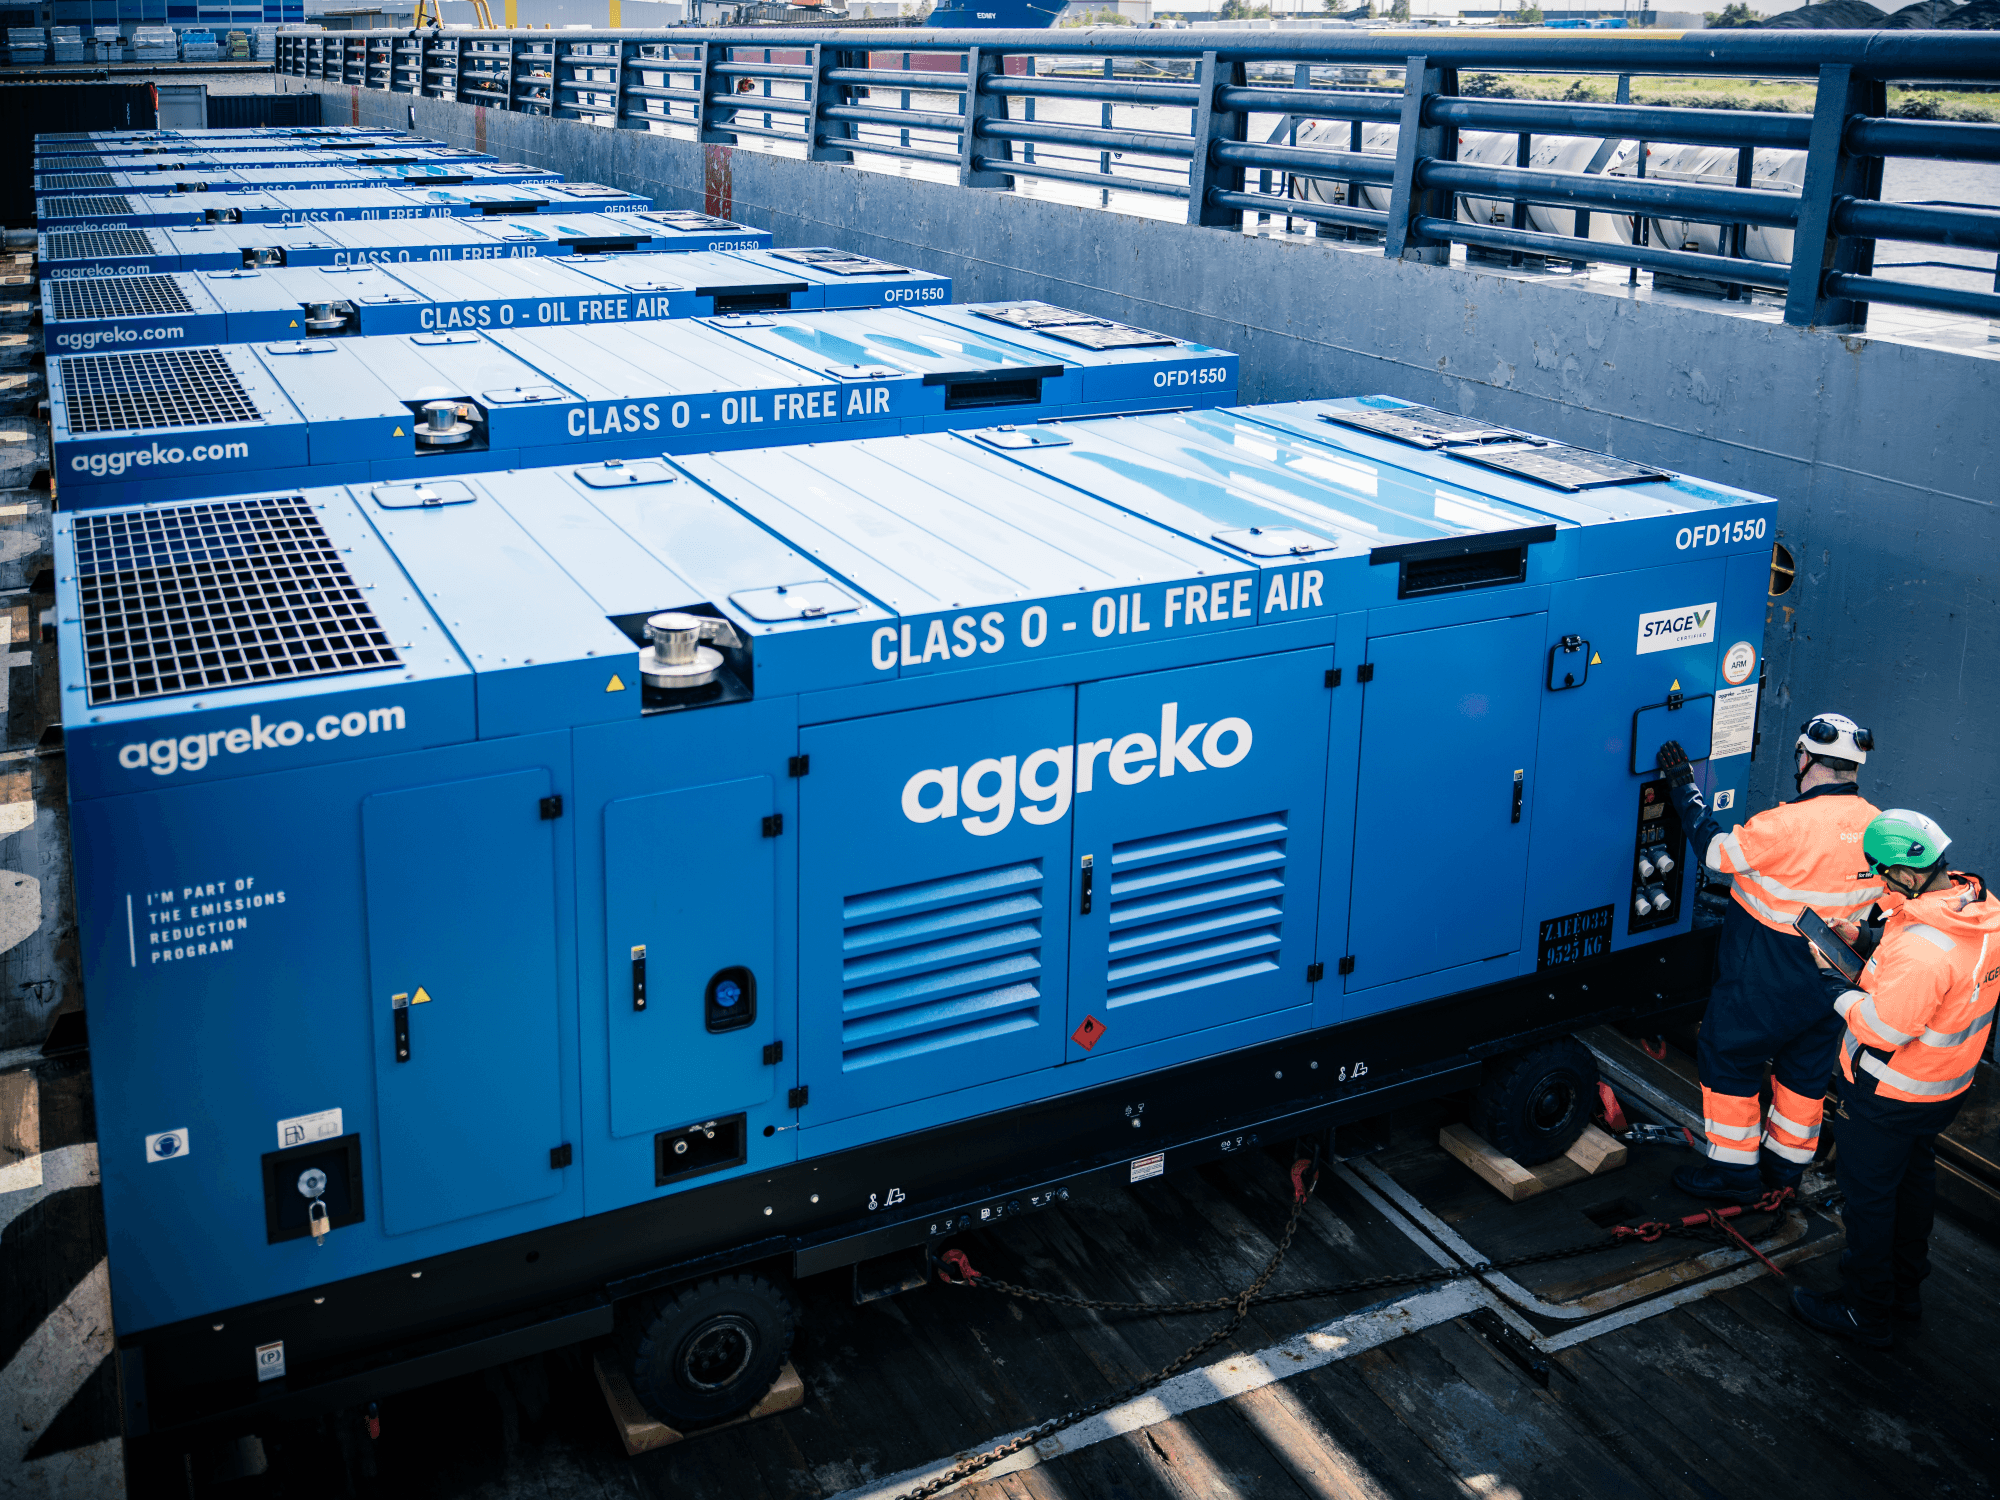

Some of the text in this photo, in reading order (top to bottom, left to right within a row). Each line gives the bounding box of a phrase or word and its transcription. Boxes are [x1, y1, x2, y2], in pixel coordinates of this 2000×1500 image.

[334, 250, 392, 266] CLASS
[462, 246, 503, 261] FREE
[510, 245, 538, 259] AIR
[708, 240, 760, 252] OFD1550
[50, 263, 150, 279] aggreko.com
[884, 287, 945, 302] OFD1550
[420, 305, 492, 330] CLASS
[537, 301, 571, 324] OIL
[578, 298, 628, 321] FREE
[635, 297, 671, 319] AIR
[56, 325, 185, 350] aggreko.com
[1152, 366, 1229, 389] OFD1550
[565, 402, 662, 438] CLASS
[721, 395, 764, 426] OIL
[773, 389, 837, 421] FREE
[845, 386, 891, 416] AIR
[71, 440, 249, 477] aggreko.com
[1674, 516, 1767, 551] OFD1550
[870, 609, 1005, 671] CLASS
[1091, 591, 1151, 639] OIL
[1164, 577, 1253, 629] FREE
[1264, 568, 1325, 615] AIR
[1676, 632, 1707, 642] CERTIFIED
[1730, 659, 1748, 670] ARM
[117, 705, 407, 776] aggreko.com
[900, 701, 1254, 838] aggreko
[146, 876, 255, 906] I'M PART OF
[149, 890, 287, 925] THE EMISSIONS
[150, 917, 248, 945] REDUCTION
[151, 937, 234, 964] PROGRAM
[1547, 935, 1603, 967] 9525 KG
